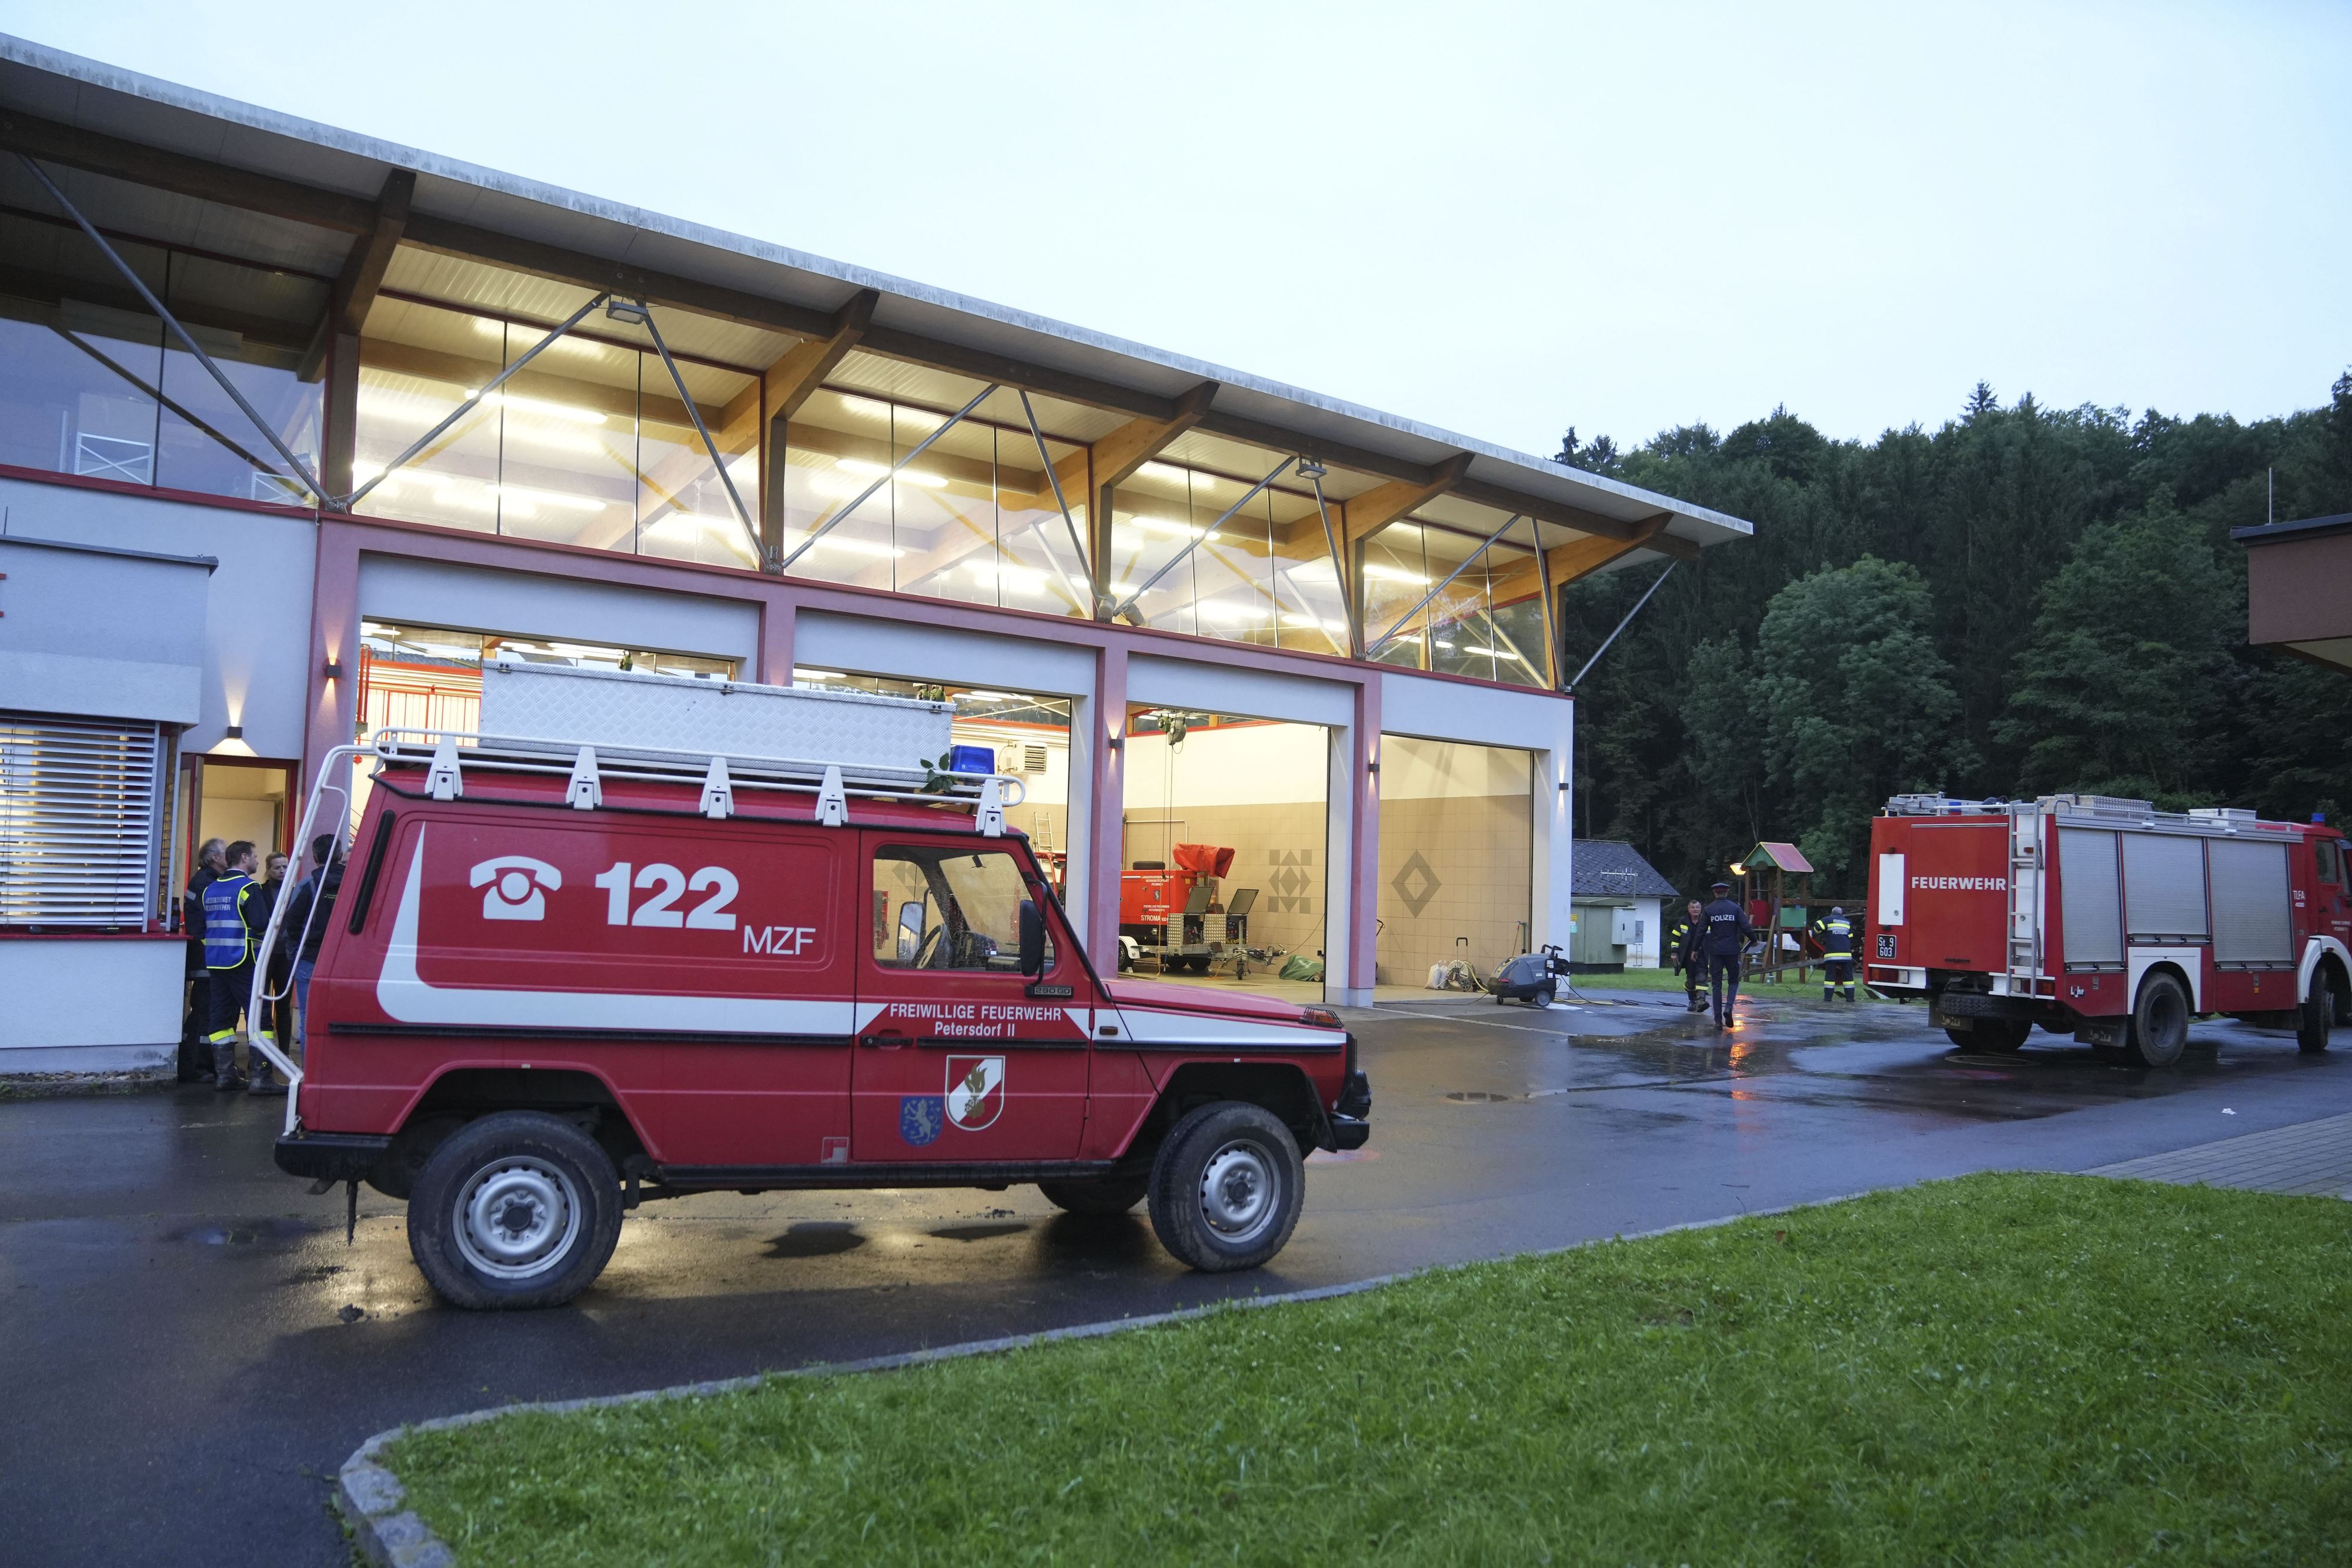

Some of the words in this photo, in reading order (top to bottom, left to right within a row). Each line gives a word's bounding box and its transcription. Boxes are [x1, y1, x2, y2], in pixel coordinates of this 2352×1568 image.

[1912, 877, 2006, 891] FEUERWEHR
[595, 862, 739, 930] 122
[2293, 890, 2305, 900] TLFA
[1710, 914, 1735, 922] POLIZEI
[743, 925, 816, 955] MZF
[1879, 937, 1885, 947] St
[1889, 938, 1893, 947] 9
[1880, 947, 1892, 957] 603
[890, 1003, 975, 1019] FREIWILLIGE
[981, 1006, 1061, 1021] FEUERWEHR
[935, 1021, 1001, 1037] Petersdorf
[1007, 1024, 1015, 1037] II
